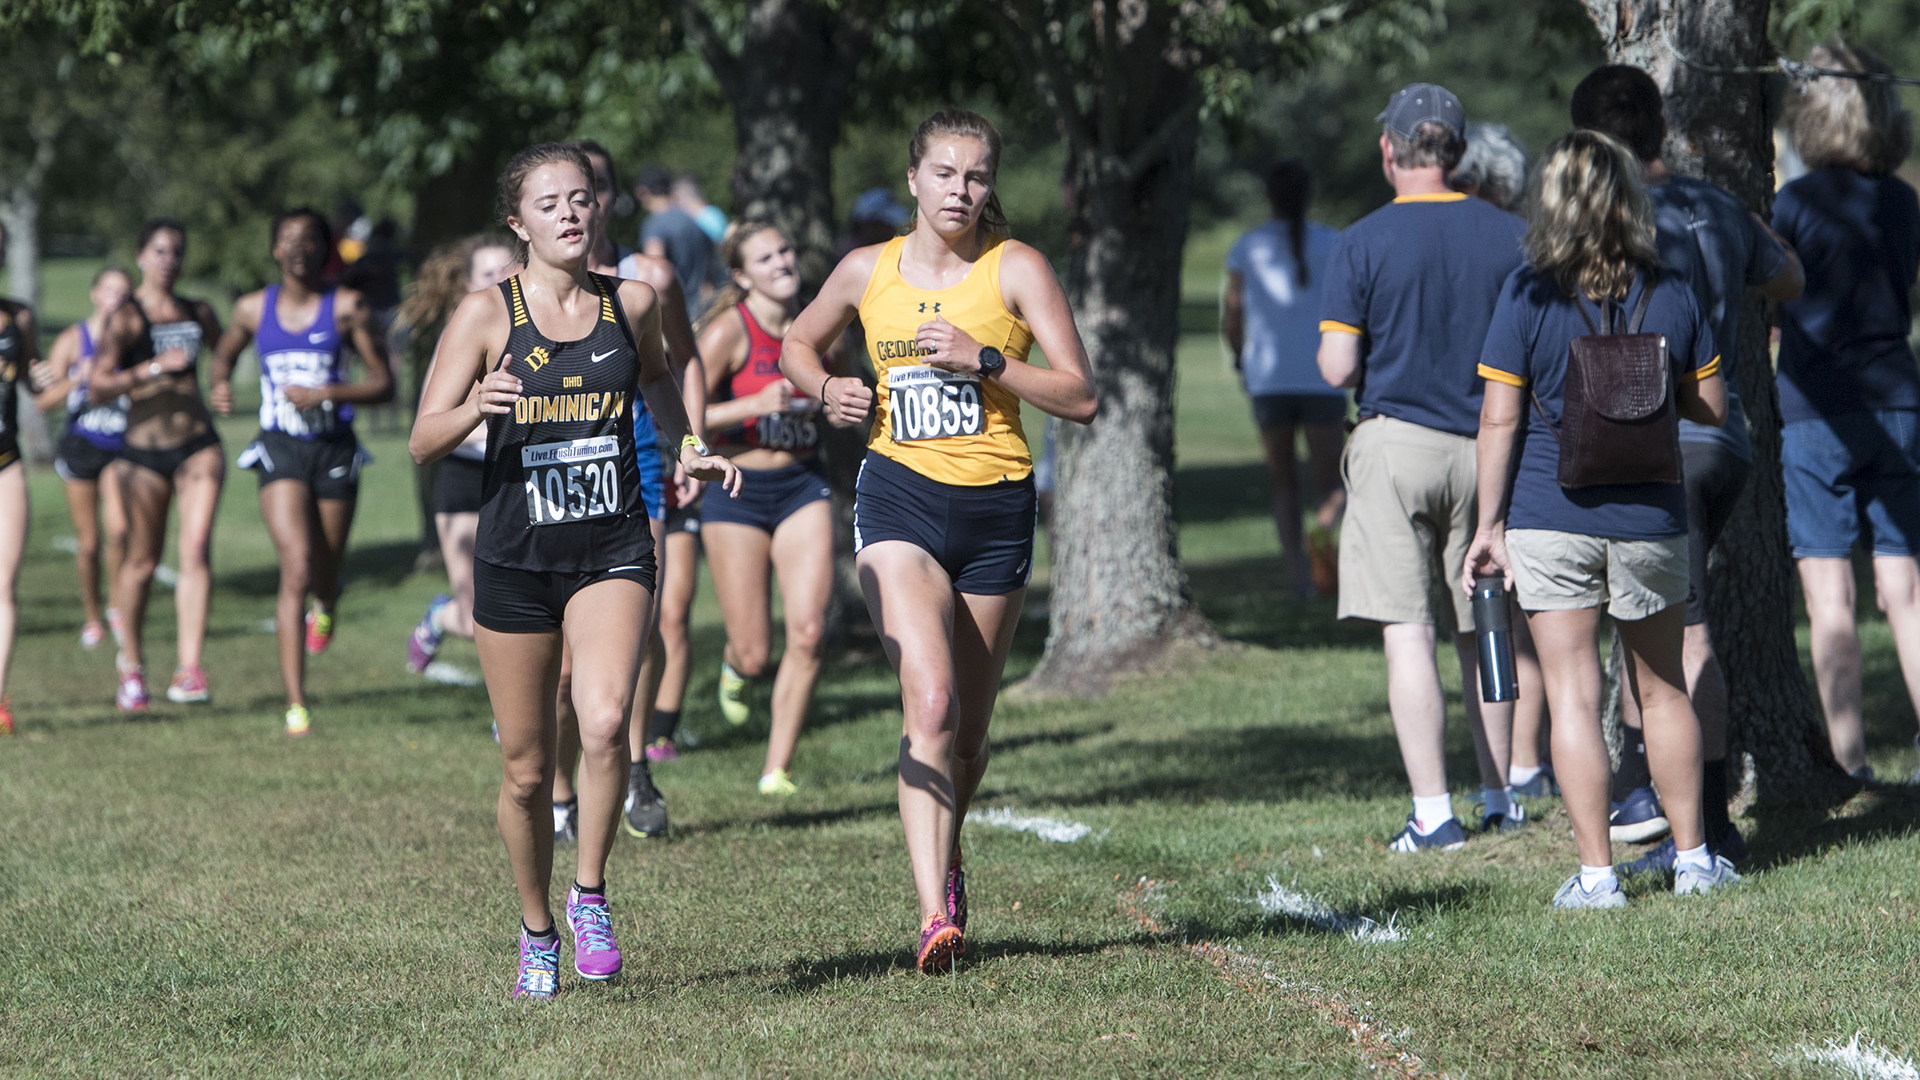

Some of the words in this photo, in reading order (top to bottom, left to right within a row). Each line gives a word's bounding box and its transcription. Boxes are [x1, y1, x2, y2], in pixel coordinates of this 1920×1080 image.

[563, 376, 583, 388] OHIO
[516, 392, 624, 424] DOMINICAN
[891, 384, 980, 440] 10859
[526, 460, 618, 523] 10520
